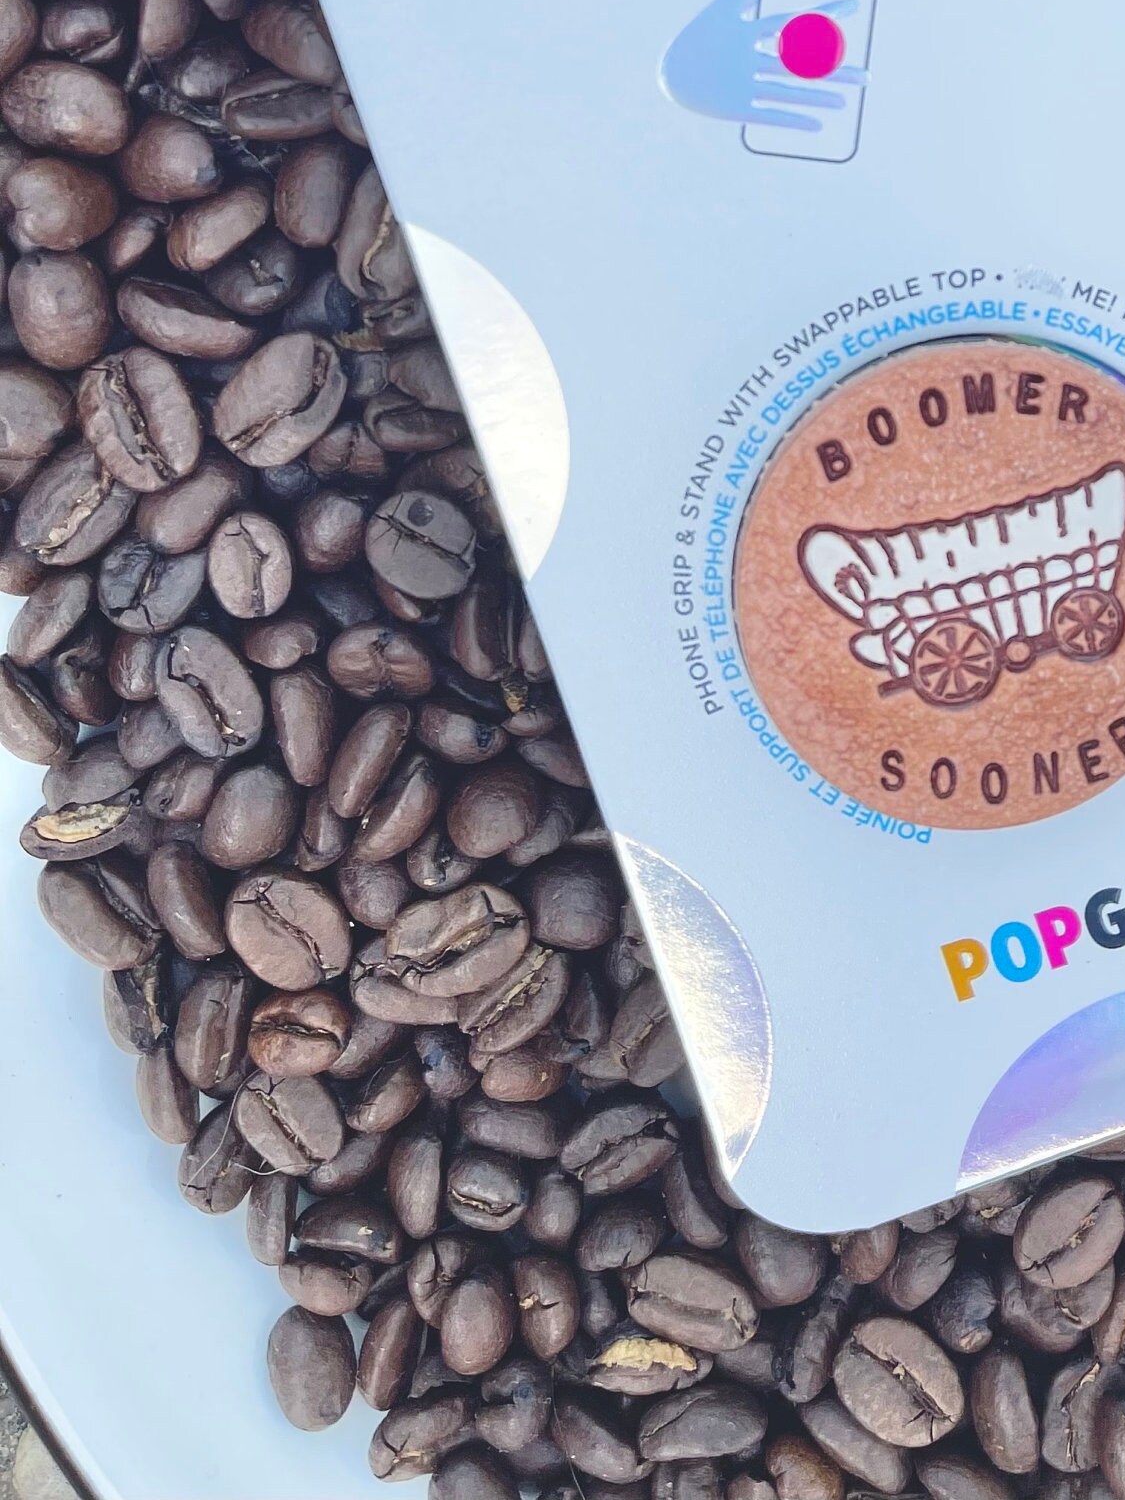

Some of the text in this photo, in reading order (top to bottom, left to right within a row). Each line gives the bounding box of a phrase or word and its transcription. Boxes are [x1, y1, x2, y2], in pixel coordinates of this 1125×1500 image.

[818, 372, 1091, 482] BOOMER
[1072, 280, 1118, 312] ME!
[673, 268, 986, 715] PHONE GRIP & STAND WITH SWAPPABLE TOP
[700, 300, 1027, 844] POINÉE ET SUPPORT DE TÉLÉPHONE AVEC DESSUS ÉCHANGEABLE
